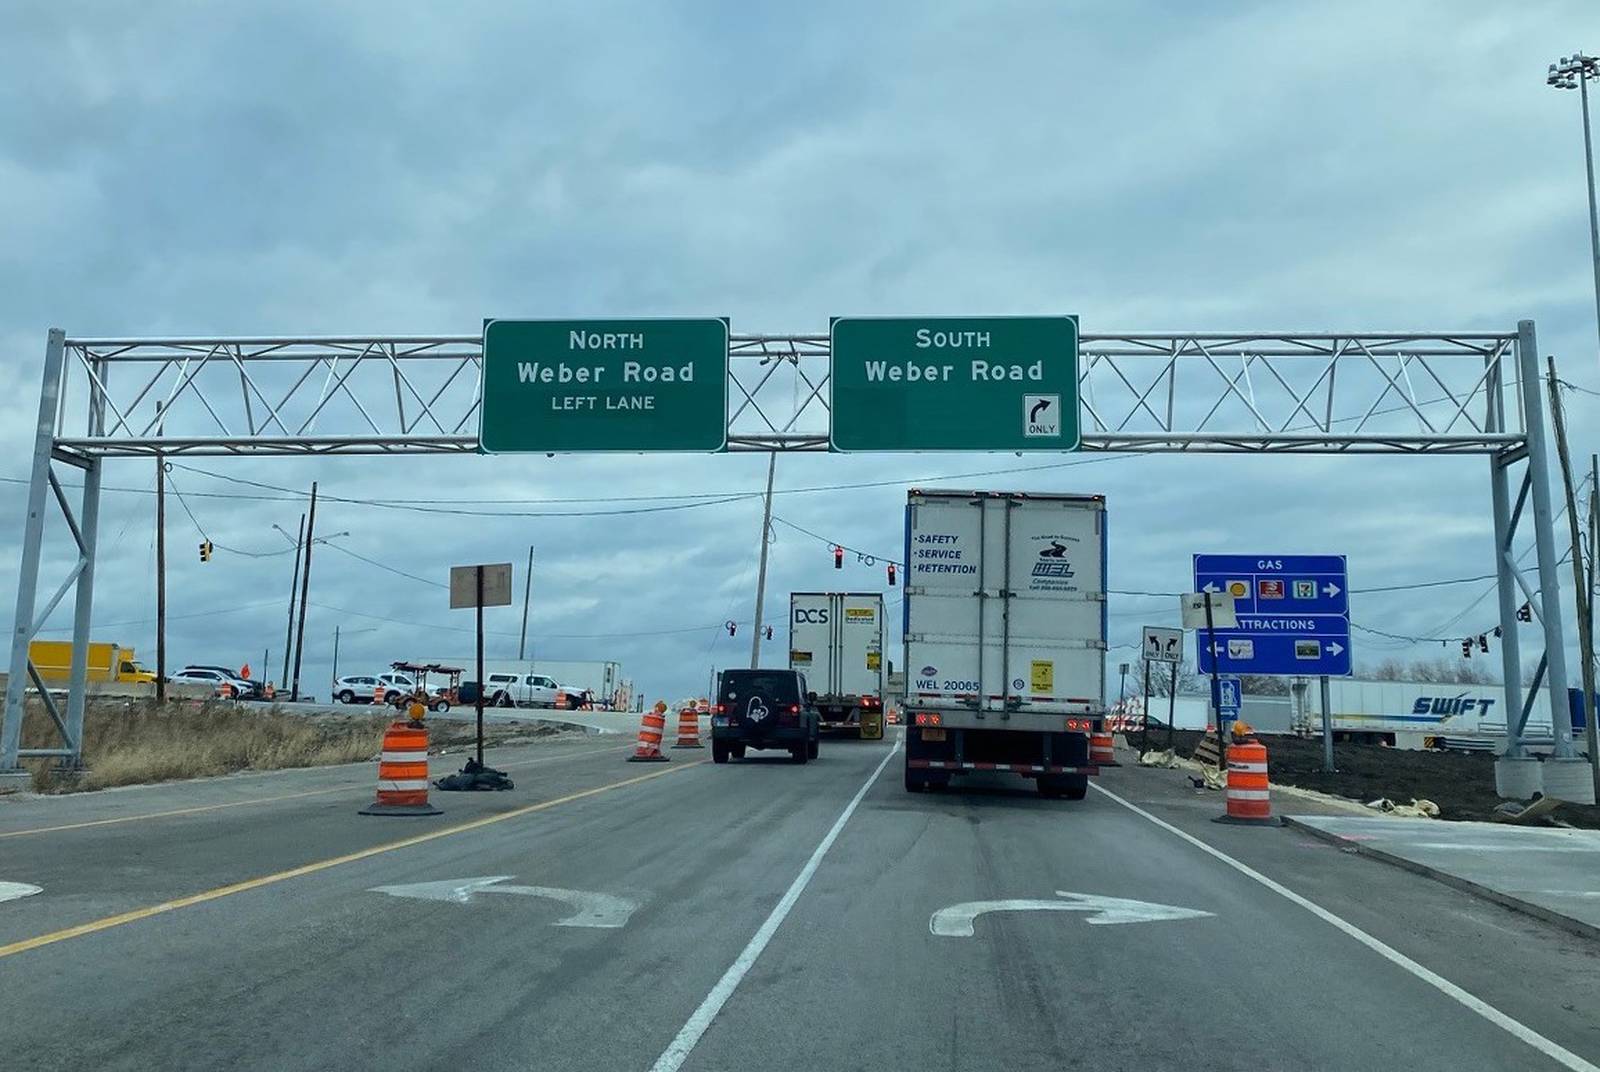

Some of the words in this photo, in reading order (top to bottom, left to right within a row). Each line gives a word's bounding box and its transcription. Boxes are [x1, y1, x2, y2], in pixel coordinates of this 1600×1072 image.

[569, 330, 644, 350] NORTH
[915, 328, 991, 348] SOUTH
[517, 361, 605, 383] Weber
[623, 361, 694, 382] Road
[865, 360, 954, 382] Weber
[971, 359, 1043, 381] Road
[551, 396, 597, 410] LEFT
[605, 395, 655, 410] LANE
[1028, 424, 1056, 434] ONLY
[918, 534, 959, 544] SAFETY
[918, 549, 962, 560] SERVICE
[917, 563, 977, 574] RETENTION
[1031, 562, 1075, 578] WEL
[1257, 560, 1283, 570] GAS
[795, 608, 829, 624] DCS
[916, 680, 939, 690] WEL
[944, 680, 980, 692] 20065
[1412, 692, 1496, 716] SWIFT
